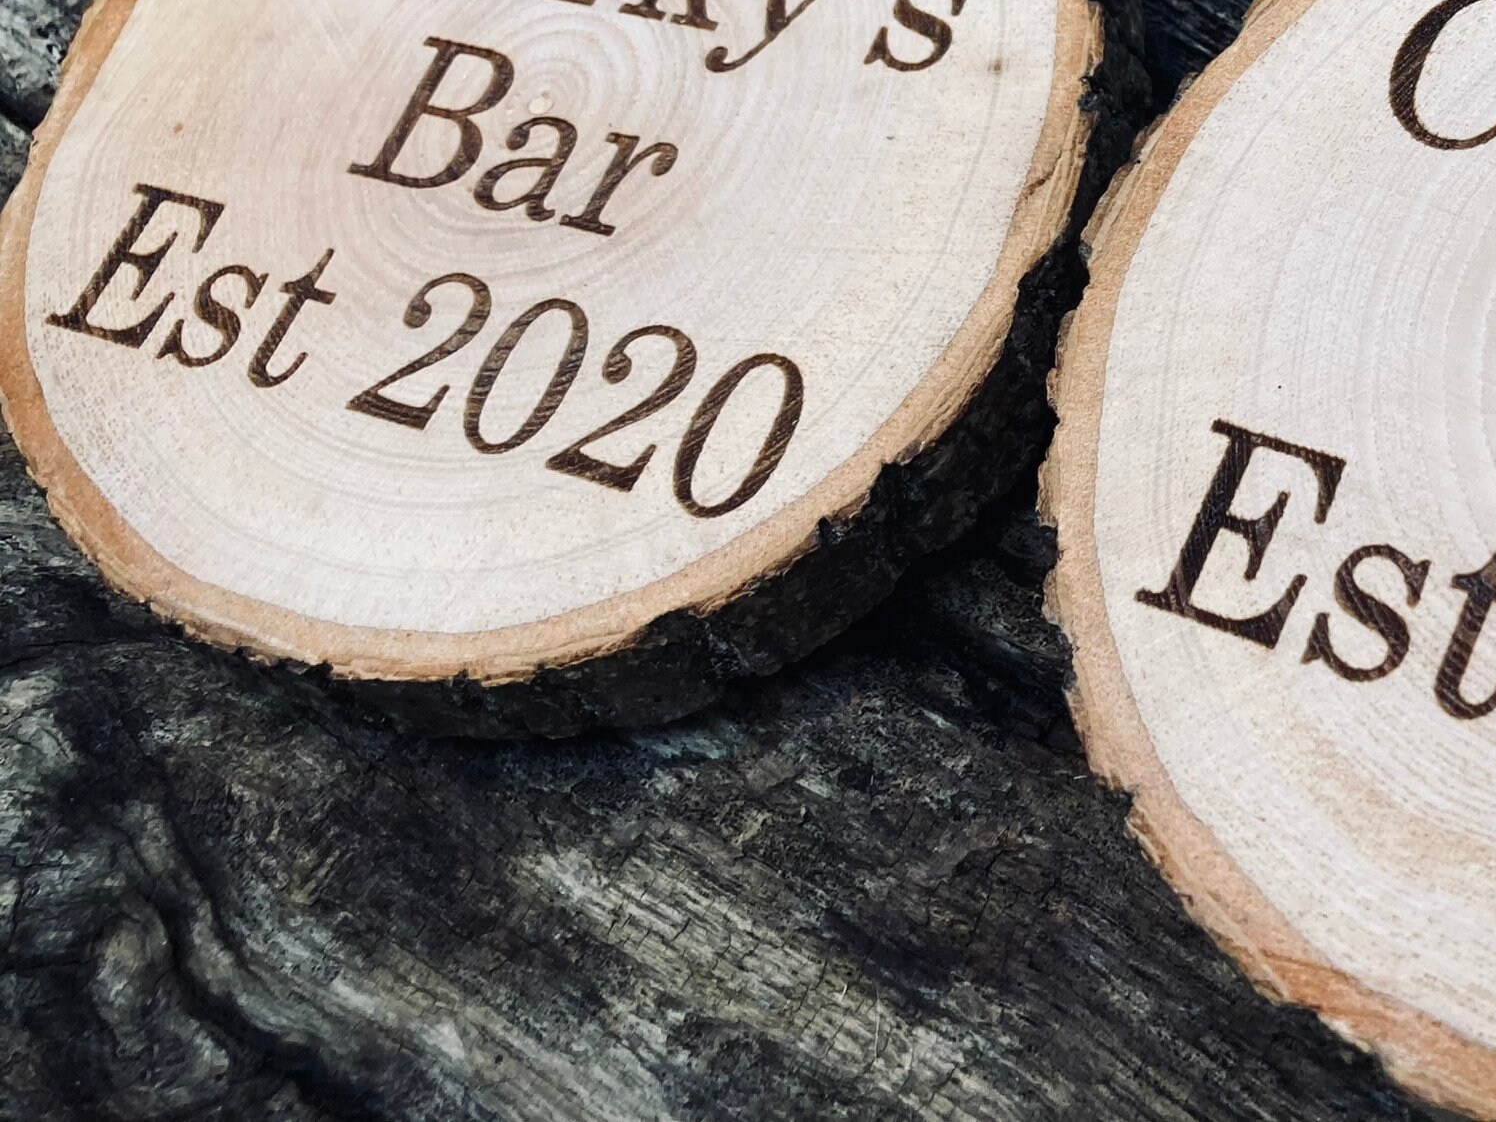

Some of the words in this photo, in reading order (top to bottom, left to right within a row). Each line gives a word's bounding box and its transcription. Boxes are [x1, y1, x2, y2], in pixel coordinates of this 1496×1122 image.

[346, 35, 680, 238] Bar
[45, 181, 337, 389] Est
[346, 271, 807, 520] 2020
